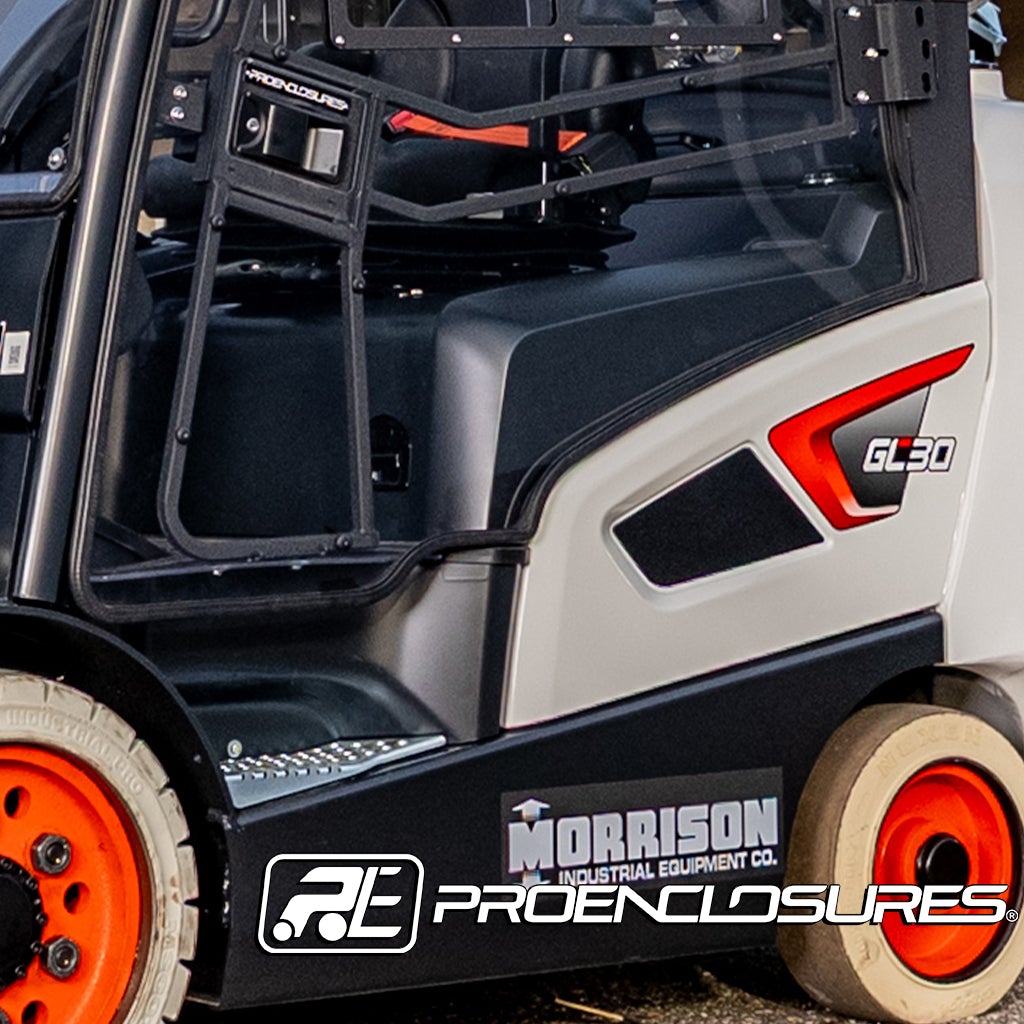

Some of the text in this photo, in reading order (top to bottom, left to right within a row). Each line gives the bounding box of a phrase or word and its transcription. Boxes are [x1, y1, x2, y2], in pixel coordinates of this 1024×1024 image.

[508, 797, 779, 874] MORRISON
[558, 848, 778, 885] INDUSTRIAL EQUIPMENT CO.
